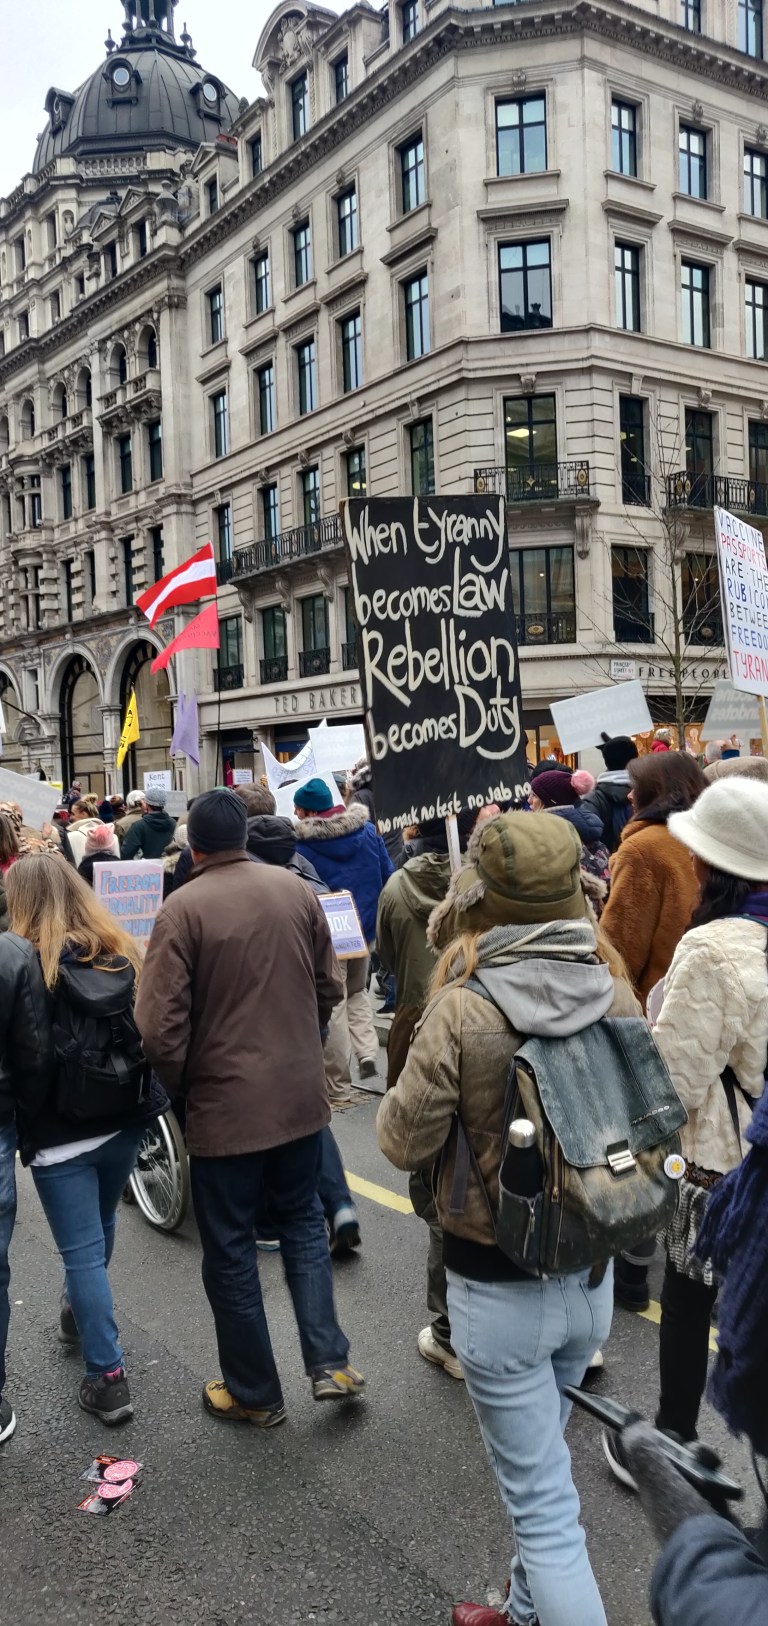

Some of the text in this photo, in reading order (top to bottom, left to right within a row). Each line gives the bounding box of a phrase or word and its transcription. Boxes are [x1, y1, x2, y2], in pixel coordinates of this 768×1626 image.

[344, 496, 505, 573] When tyranny
[718, 511, 764, 553] VACCINE
[720, 532, 768, 572] PASSPORTS
[725, 557, 744, 579] ARE
[351, 547, 508, 626] becomes Law
[727, 577, 768, 610] RUBICO
[729, 602, 768, 630] BETWEE
[731, 624, 768, 651] FREEDO
[362, 618, 515, 708] Rebellion
[681, 667, 729, 679] PEOPL
[733, 650, 768, 682] TYRAN
[274, 686, 357, 713] TED BAKER
[367, 710, 458, 761] becomes
[454, 676, 521, 761] Duty
[378, 818, 391, 834] no
[392, 805, 420, 830] mask
[421, 805, 435, 822] no
[436, 791, 462, 819] test
[467, 794, 484, 810] no
[514, 781, 532, 798] no
[101, 870, 161, 895] FREEDOM
